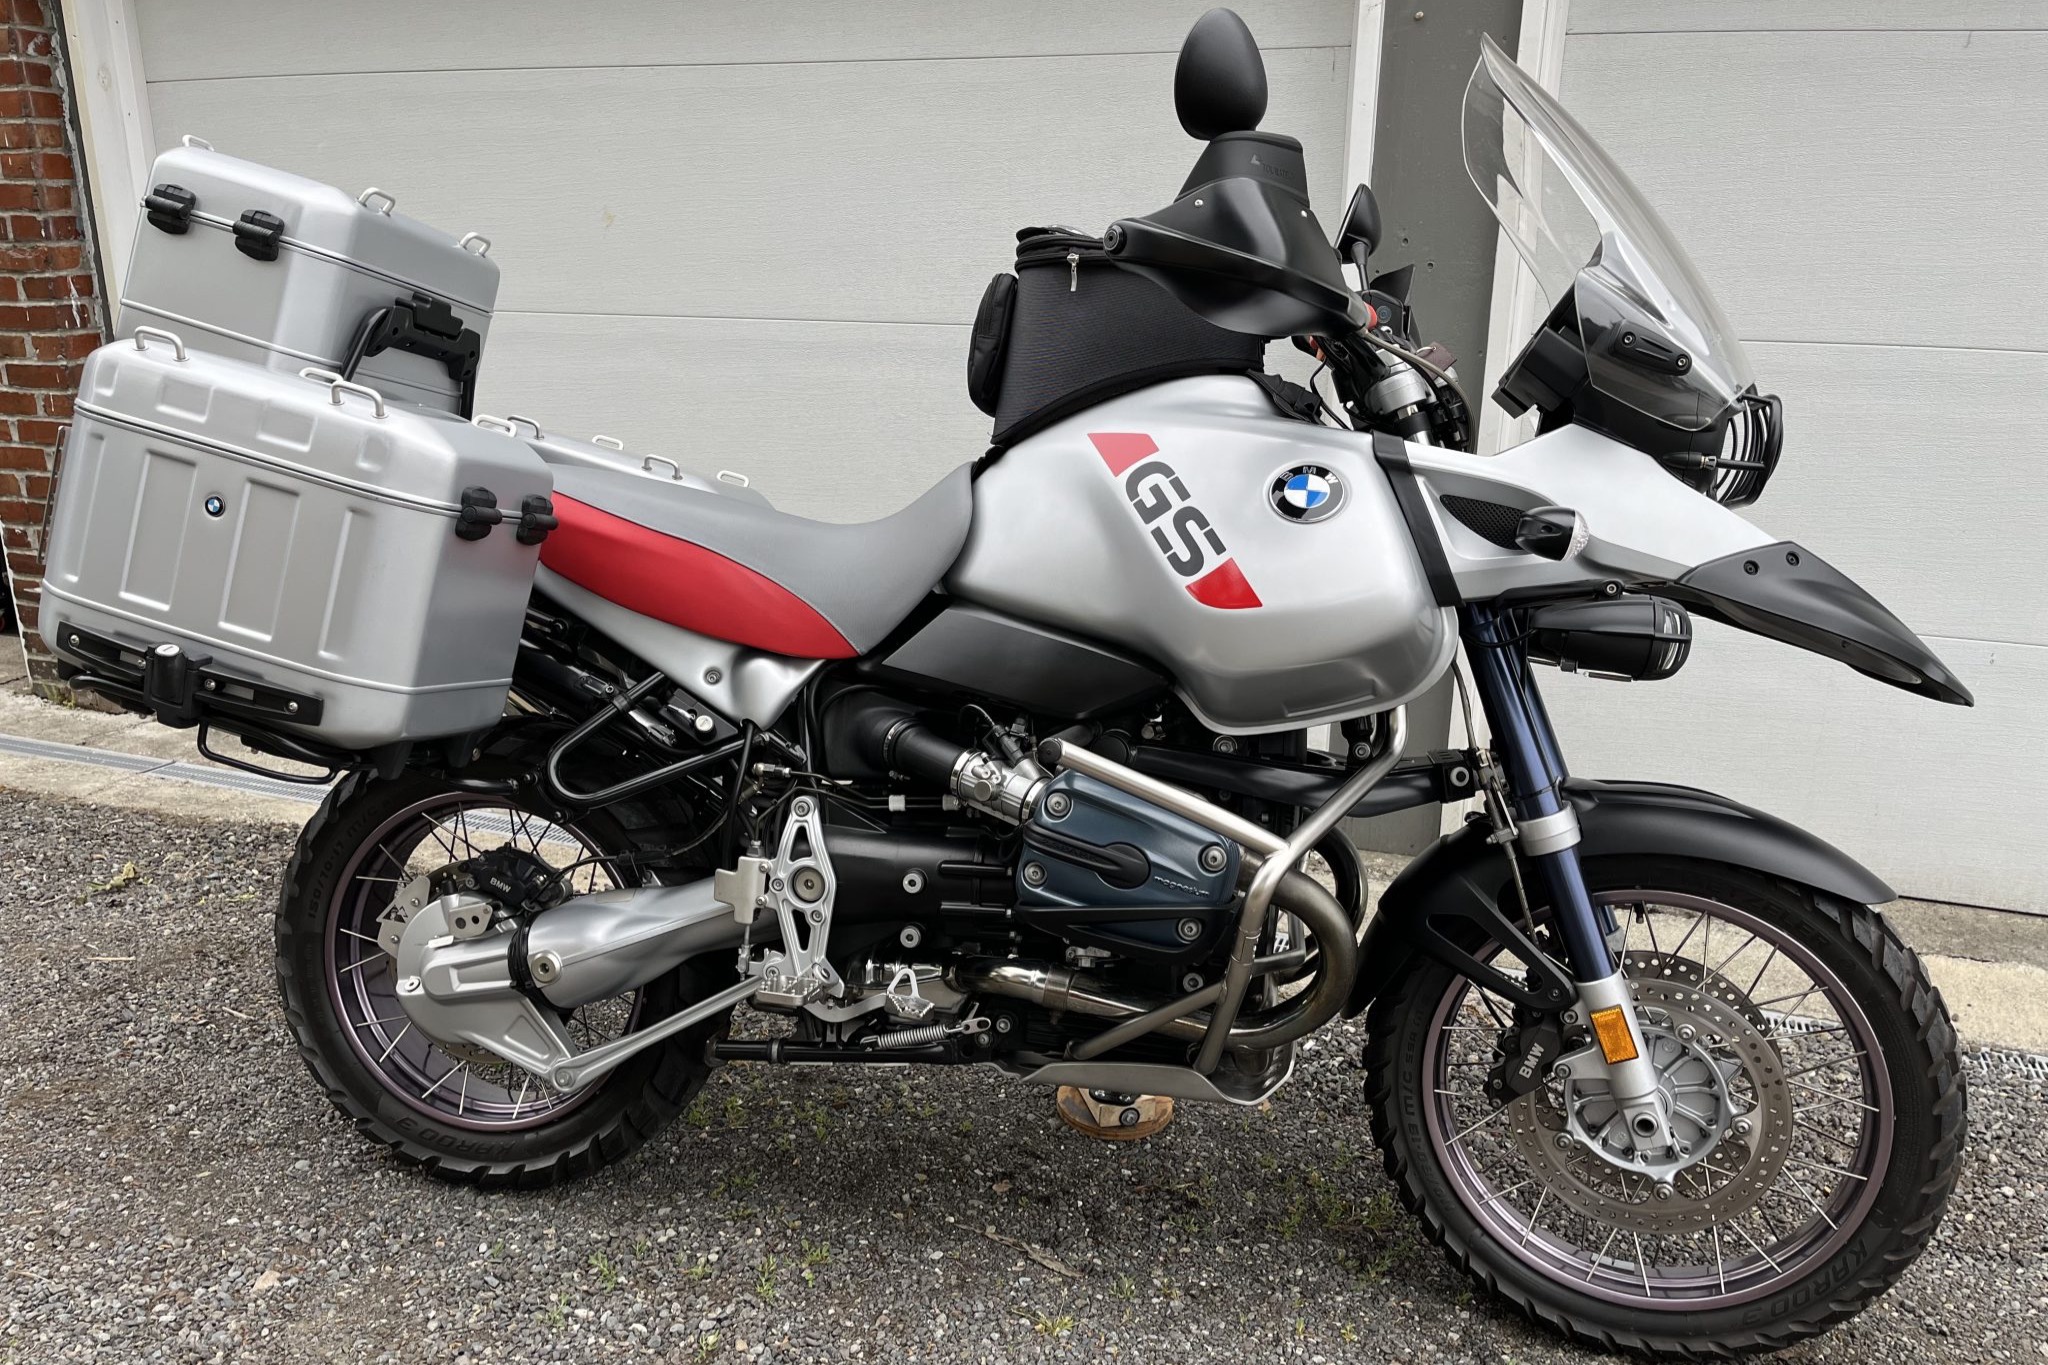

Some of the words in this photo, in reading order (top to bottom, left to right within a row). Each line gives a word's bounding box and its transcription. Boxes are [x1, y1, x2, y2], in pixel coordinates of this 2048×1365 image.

[1279, 466, 1339, 485] BMW
[1125, 460, 1227, 578] GS
[489, 876, 512, 893] BMW
[1518, 1042, 1545, 1079] BMW
[1771, 1236, 1868, 1318] KAROO
[1742, 1306, 1761, 1325] 3
